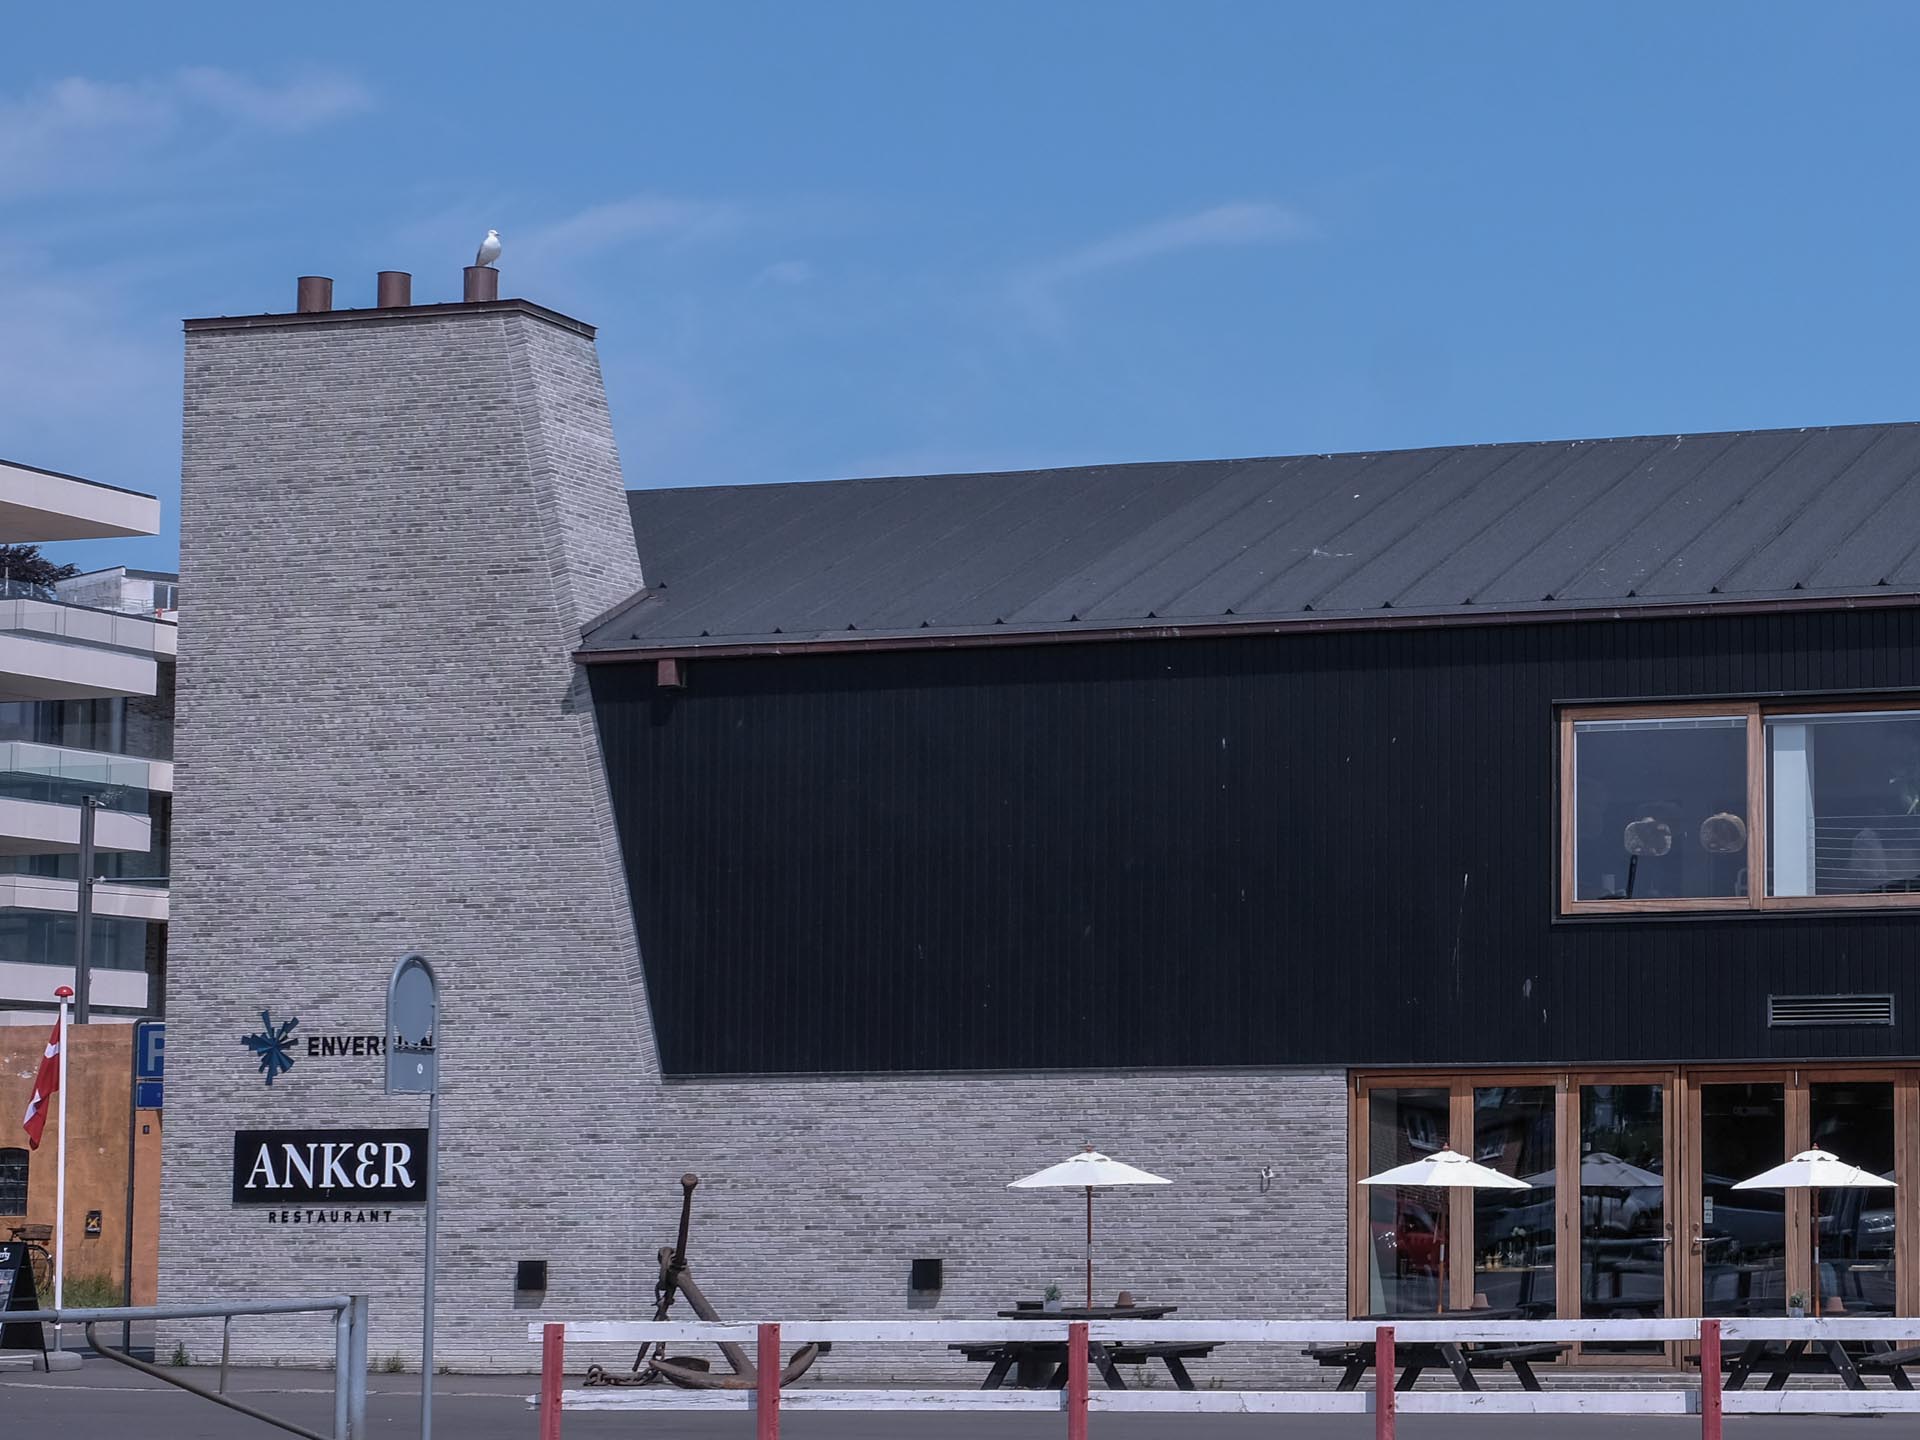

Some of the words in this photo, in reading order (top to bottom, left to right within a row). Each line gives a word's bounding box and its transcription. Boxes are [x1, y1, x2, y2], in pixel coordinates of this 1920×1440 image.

[307, 1035, 433, 1056] ENVER
[244, 1142, 416, 1189] ANKER
[268, 1210, 393, 1223] RESTAURANT
